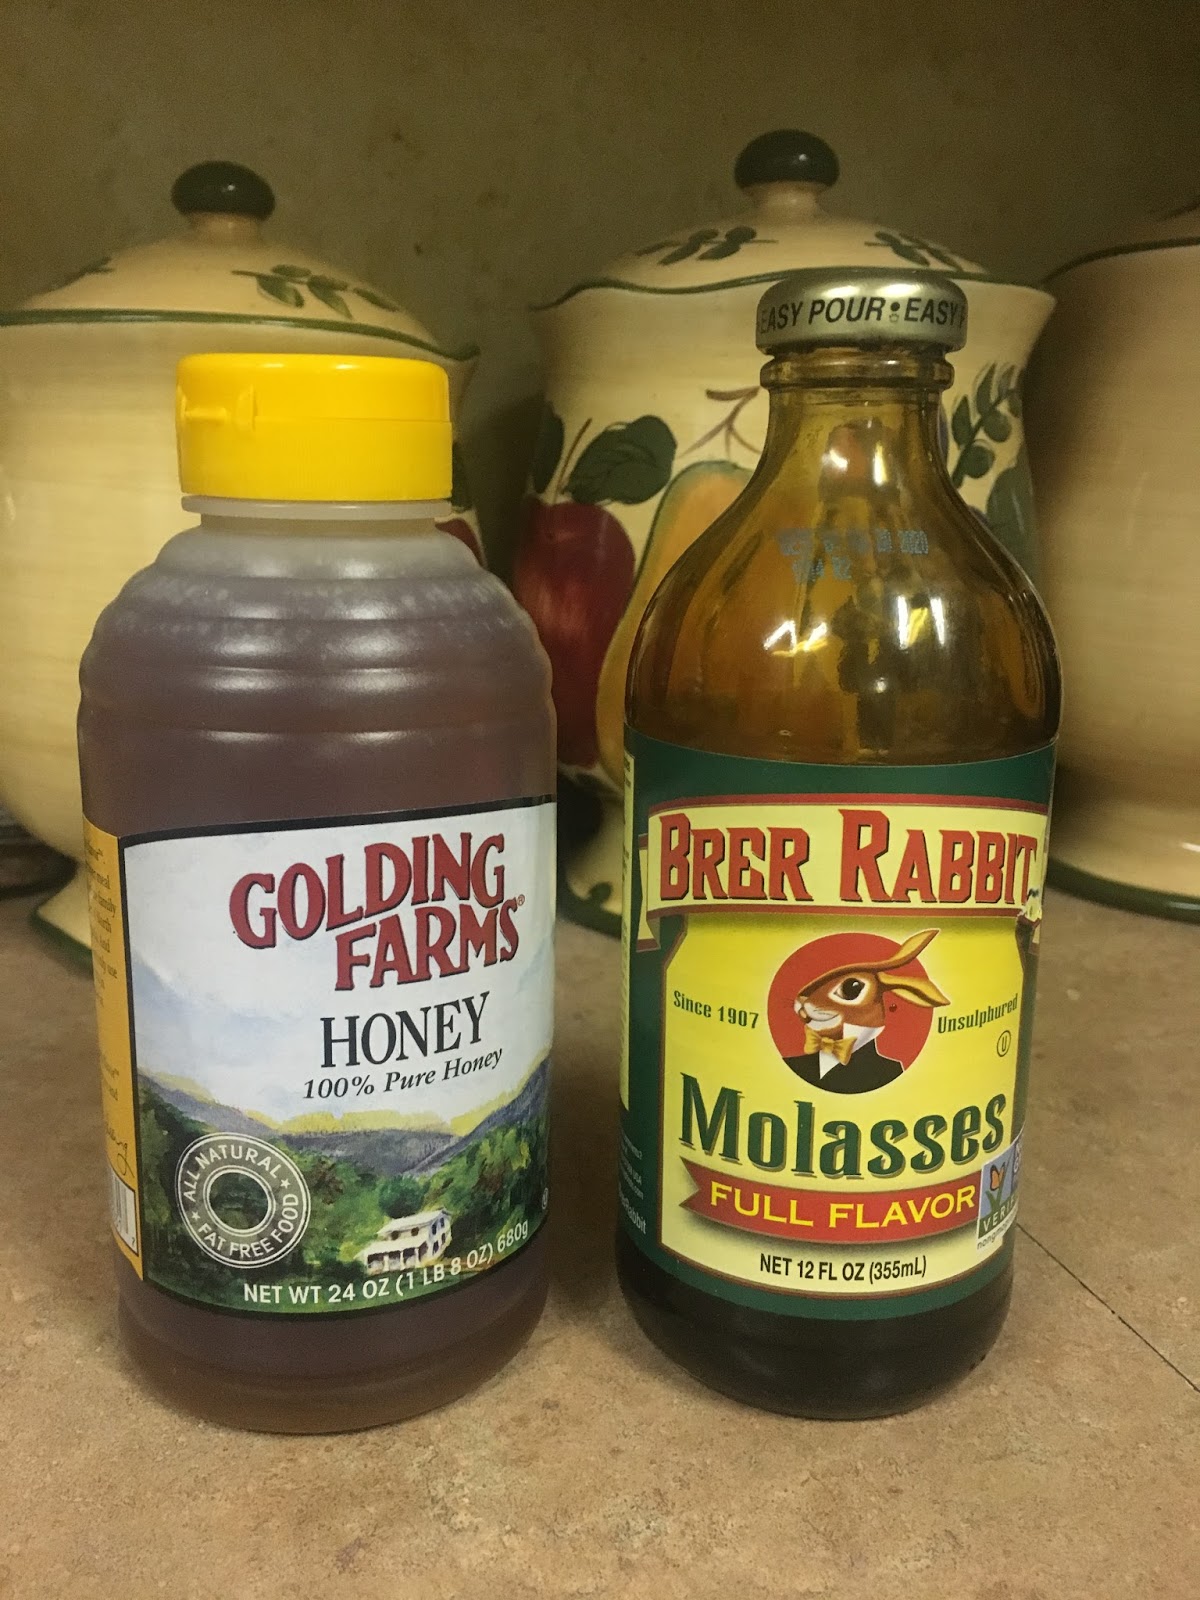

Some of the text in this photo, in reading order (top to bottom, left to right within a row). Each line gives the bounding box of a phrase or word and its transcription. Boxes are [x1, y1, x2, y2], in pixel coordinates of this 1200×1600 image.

[759, 301, 803, 334] EASY
[808, 297, 886, 325] POUR
[904, 297, 959, 326] EASY
[659, 813, 814, 902] BRER
[838, 809, 1038, 904] RABBIT
[229, 832, 505, 950] GOLDING
[335, 898, 520, 991] FARMS
[320, 991, 490, 1068] HONEY
[673, 990, 759, 1029] Since 1907
[938, 993, 1018, 1034] Unsulphured
[302, 1048, 503, 1099] 100% Pure Honey
[679, 1072, 1007, 1180] Molasses
[183, 1144, 282, 1203] ALL NATURAL
[198, 1193, 299, 1258] FAT FREE FOOD
[710, 1181, 976, 1229] FULL FLAVOR
[243, 1283, 282, 1304] NET
[289, 1285, 322, 1304] WT
[328, 1284, 355, 1303] 24
[362, 1277, 390, 1299] OZ
[423, 1265, 445, 1286] LB
[450, 1260, 462, 1276] 8
[497, 1220, 529, 1253] 680g
[760, 1253, 927, 1285] NET 12 FL OZ (355mL)
